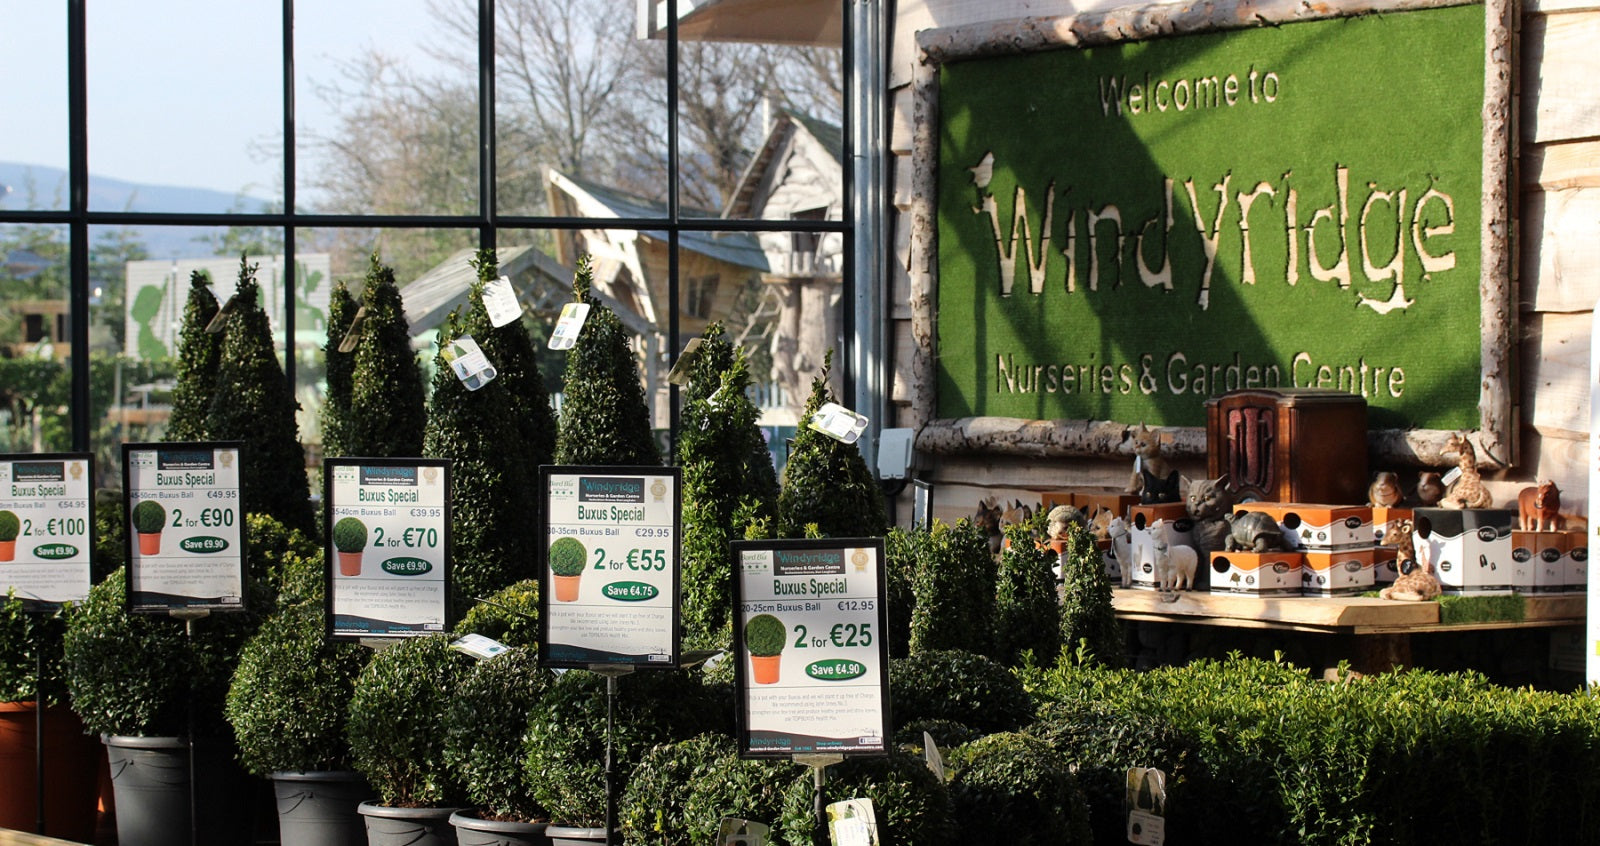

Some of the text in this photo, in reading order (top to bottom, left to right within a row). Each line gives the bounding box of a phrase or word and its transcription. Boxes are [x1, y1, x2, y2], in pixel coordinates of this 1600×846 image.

[1099, 63, 1279, 117] Welcome to
[973, 160, 1457, 315] Windyridge
[996, 351, 1405, 398] Nurseries & Garden Centre
[157, 472, 216, 488] Buxus Special
[582, 478, 640, 494] Windyridge
[12, 484, 66, 499] Buxus Special
[180, 490, 194, 498] Ball
[207, 490, 237, 499] €49.95
[359, 488, 420, 505] Buxus Special
[58, 501, 86, 509] €54.95
[360, 508, 382, 516] Buxus
[384, 508, 396, 516] Ball
[410, 508, 441, 518] €39.95
[172, 508, 234, 528] 2 for €90
[578, 505, 646, 524] Buxus Special
[24, 518, 85, 537] 2 for €100
[579, 528, 604, 536] Buxus
[606, 528, 620, 536] Ball
[635, 528, 670, 538] €29.95
[184, 539, 224, 550] Save €9.90
[374, 527, 438, 548] 2 for €70
[38, 546, 74, 556] Save €9.90
[779, 551, 840, 564] Windyridge
[386, 560, 427, 572] Save €9.90
[594, 548, 666, 572] 2 for €55
[608, 585, 653, 598] Save €4.75
[774, 578, 848, 598] Buxus Special
[742, 600, 874, 613] 20-25cm Buxus Ball €12.95
[794, 623, 872, 648] 2 for €25
[811, 662, 860, 676] Save €4.90
